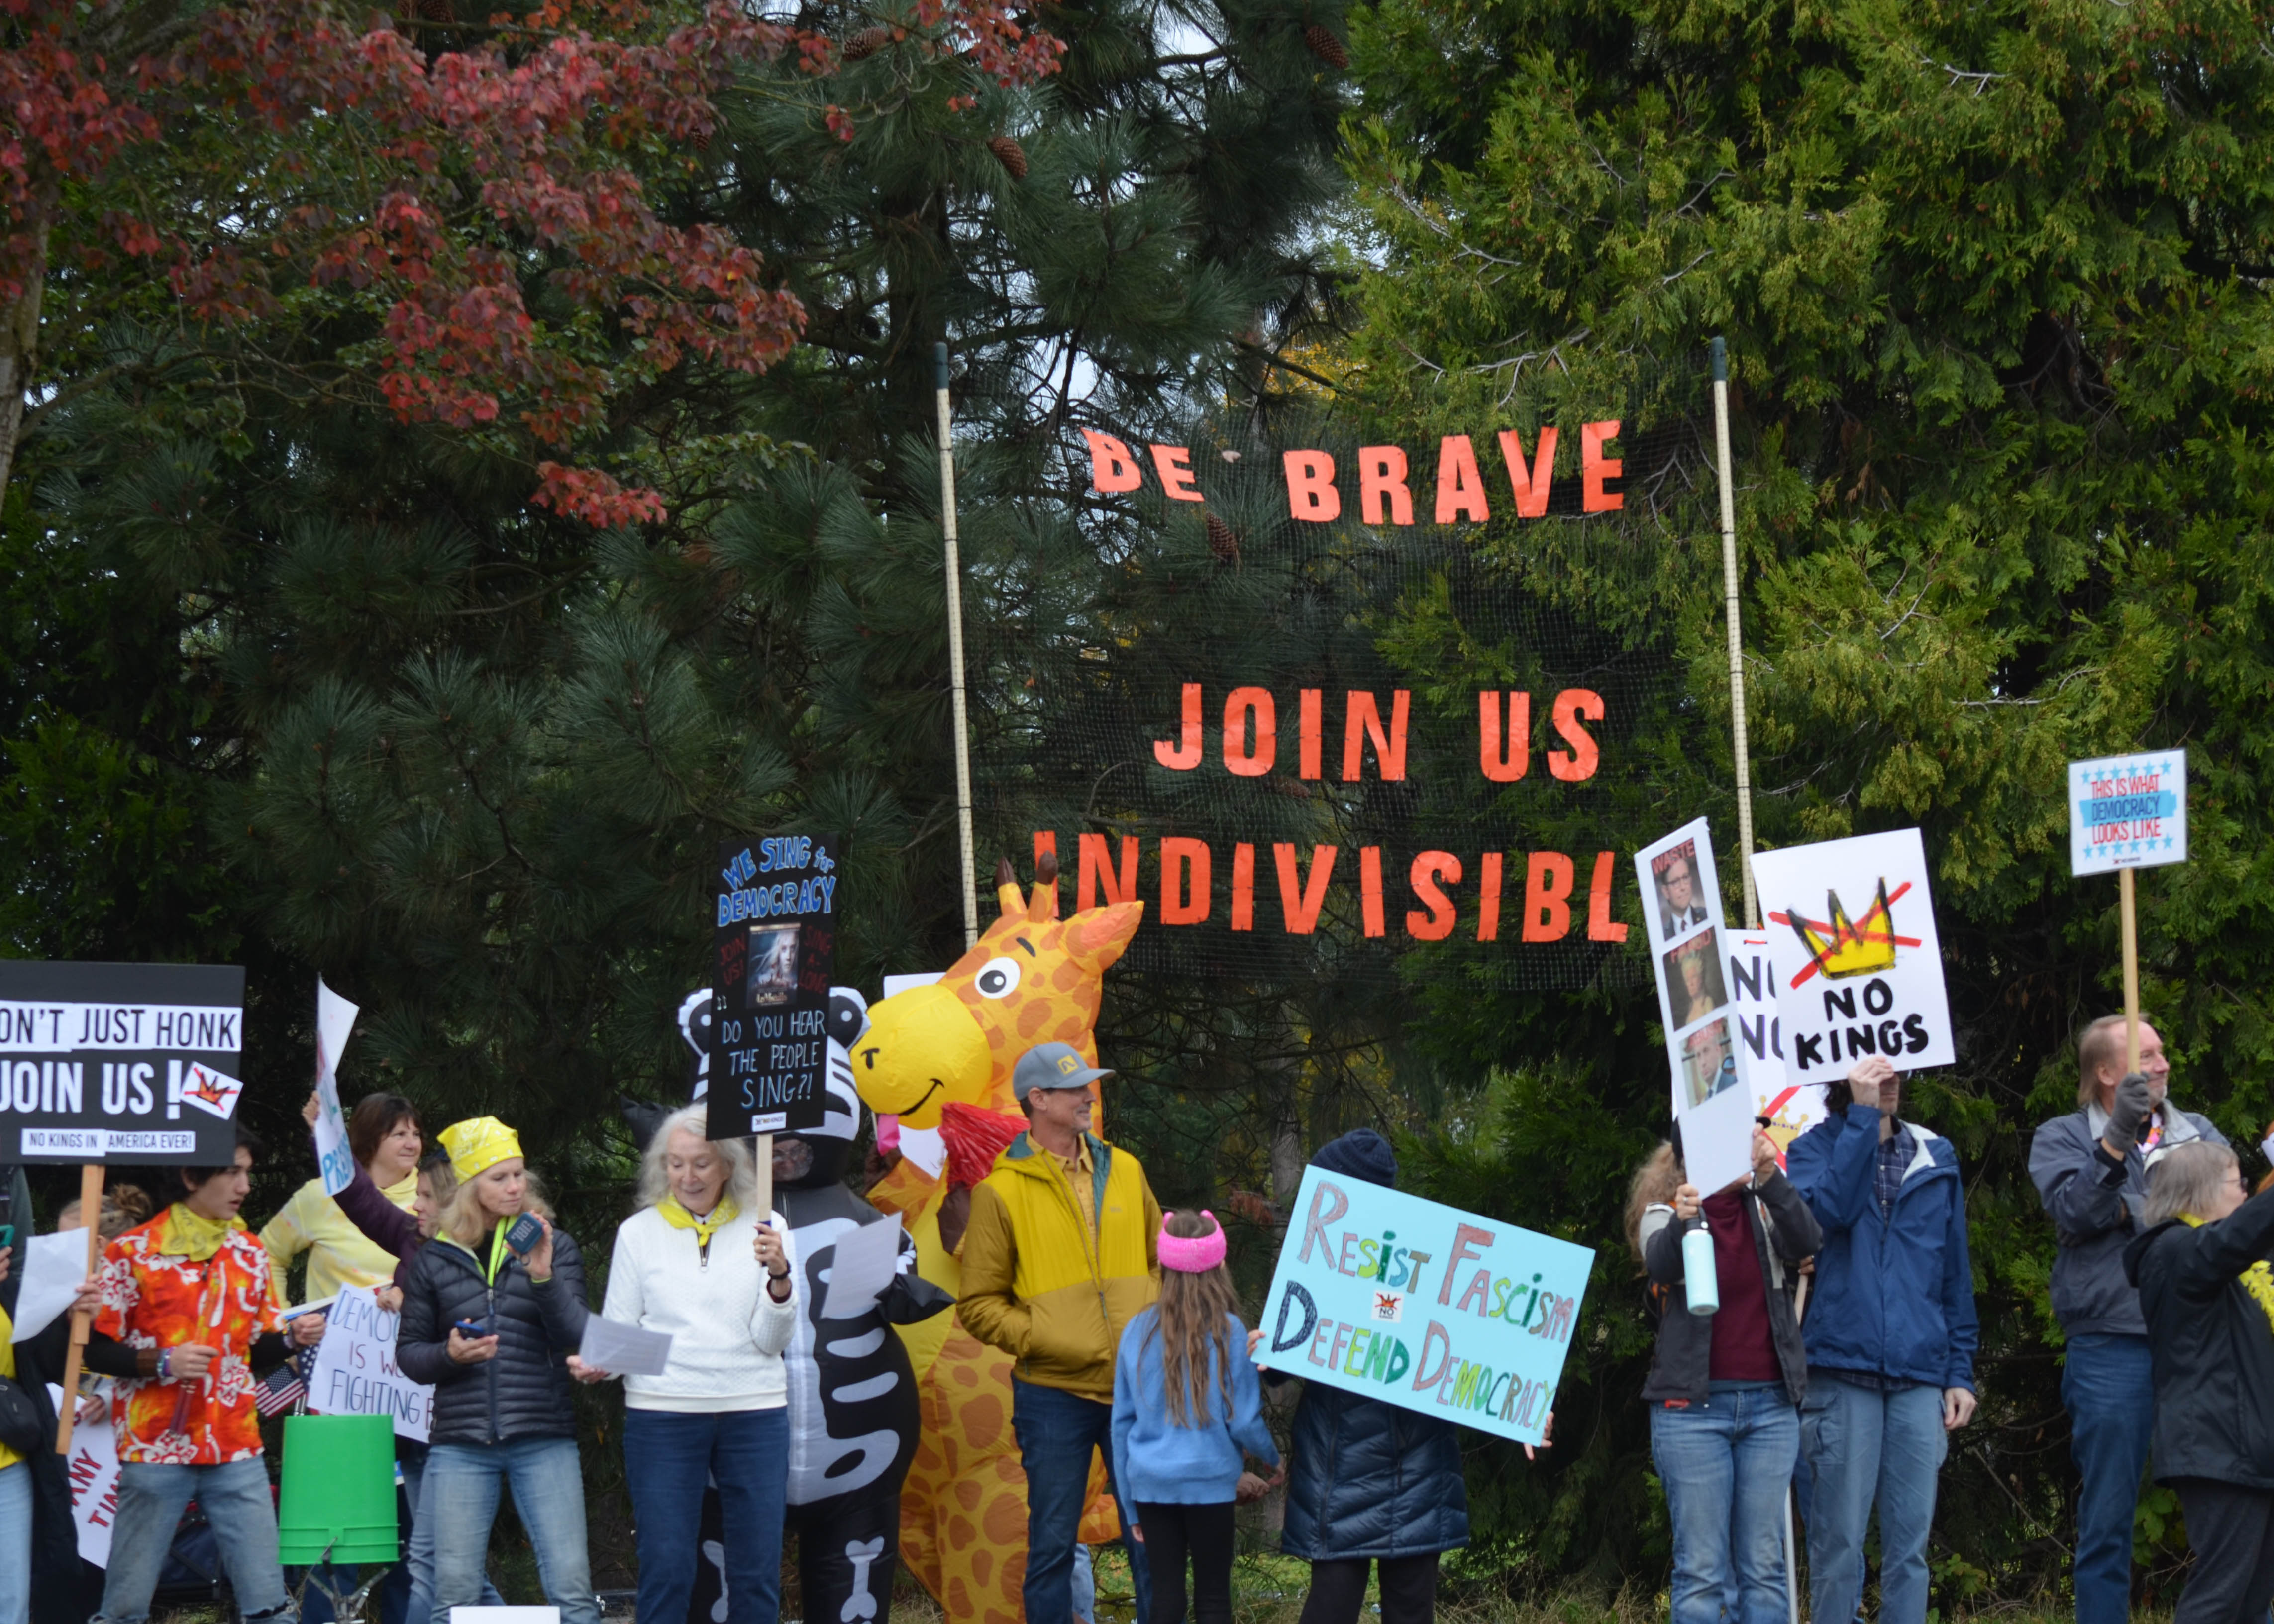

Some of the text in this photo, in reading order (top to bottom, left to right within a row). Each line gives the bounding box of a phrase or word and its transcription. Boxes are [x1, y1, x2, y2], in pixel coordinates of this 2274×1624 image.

[1080, 420, 1624, 525] BE BRAVE
[1153, 682, 1605, 783] JOIN US
[2091, 774, 2160, 800] THIS IS WHAT
[2091, 795, 2160, 822] DEMOCRACY
[2092, 817, 2162, 845] LOOKS LIKE
[722, 848, 757, 892] WE
[759, 836, 812, 873] SING
[1650, 837, 1696, 875] WASTE
[717, 875, 836, 927] DEMOCRACY
[720, 932, 746, 966] JOIN
[1823, 978, 1894, 1022] NO
[78, 1009, 146, 1044] JUST
[156, 1012, 238, 1048] HONK
[723, 1010, 826, 1044] DO YOU HEAR
[1795, 1014, 1929, 1070] KINGS
[729, 1041, 820, 1076] THE PEOPLE
[0, 1060, 83, 1114] JOIN
[740, 1072, 813, 1109] SING?!
[30, 1133, 193, 1148] NO KINGS IN AMERICA EVER!
[511, 1220, 535, 1242] JBL
[1379, 1307, 1394, 1316] NO
[349, 1341, 366, 1369] IS
[1271, 1280, 1558, 1431] DEFEND DEMOCRACY
[328, 1369, 420, 1424] FIGHTING
